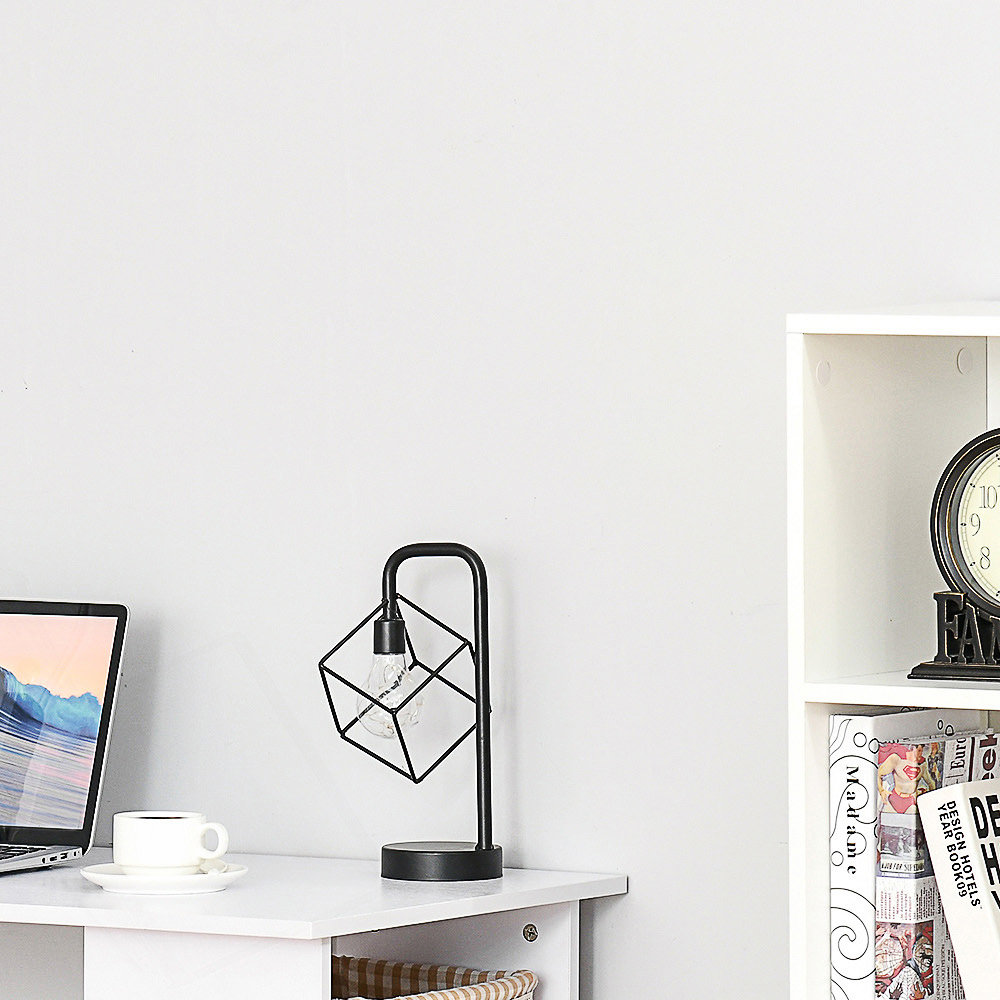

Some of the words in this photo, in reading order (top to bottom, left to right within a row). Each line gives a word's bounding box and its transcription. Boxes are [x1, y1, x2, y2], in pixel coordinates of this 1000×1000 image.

[979, 485, 998, 509] 10
[970, 513, 981, 536] 9
[980, 546, 991, 569] 8
[847, 766, 860, 874] Madame
[938, 803, 954, 839] YEAR
[946, 801, 967, 850] DESIGN
[960, 855, 981, 906] HOTELS
